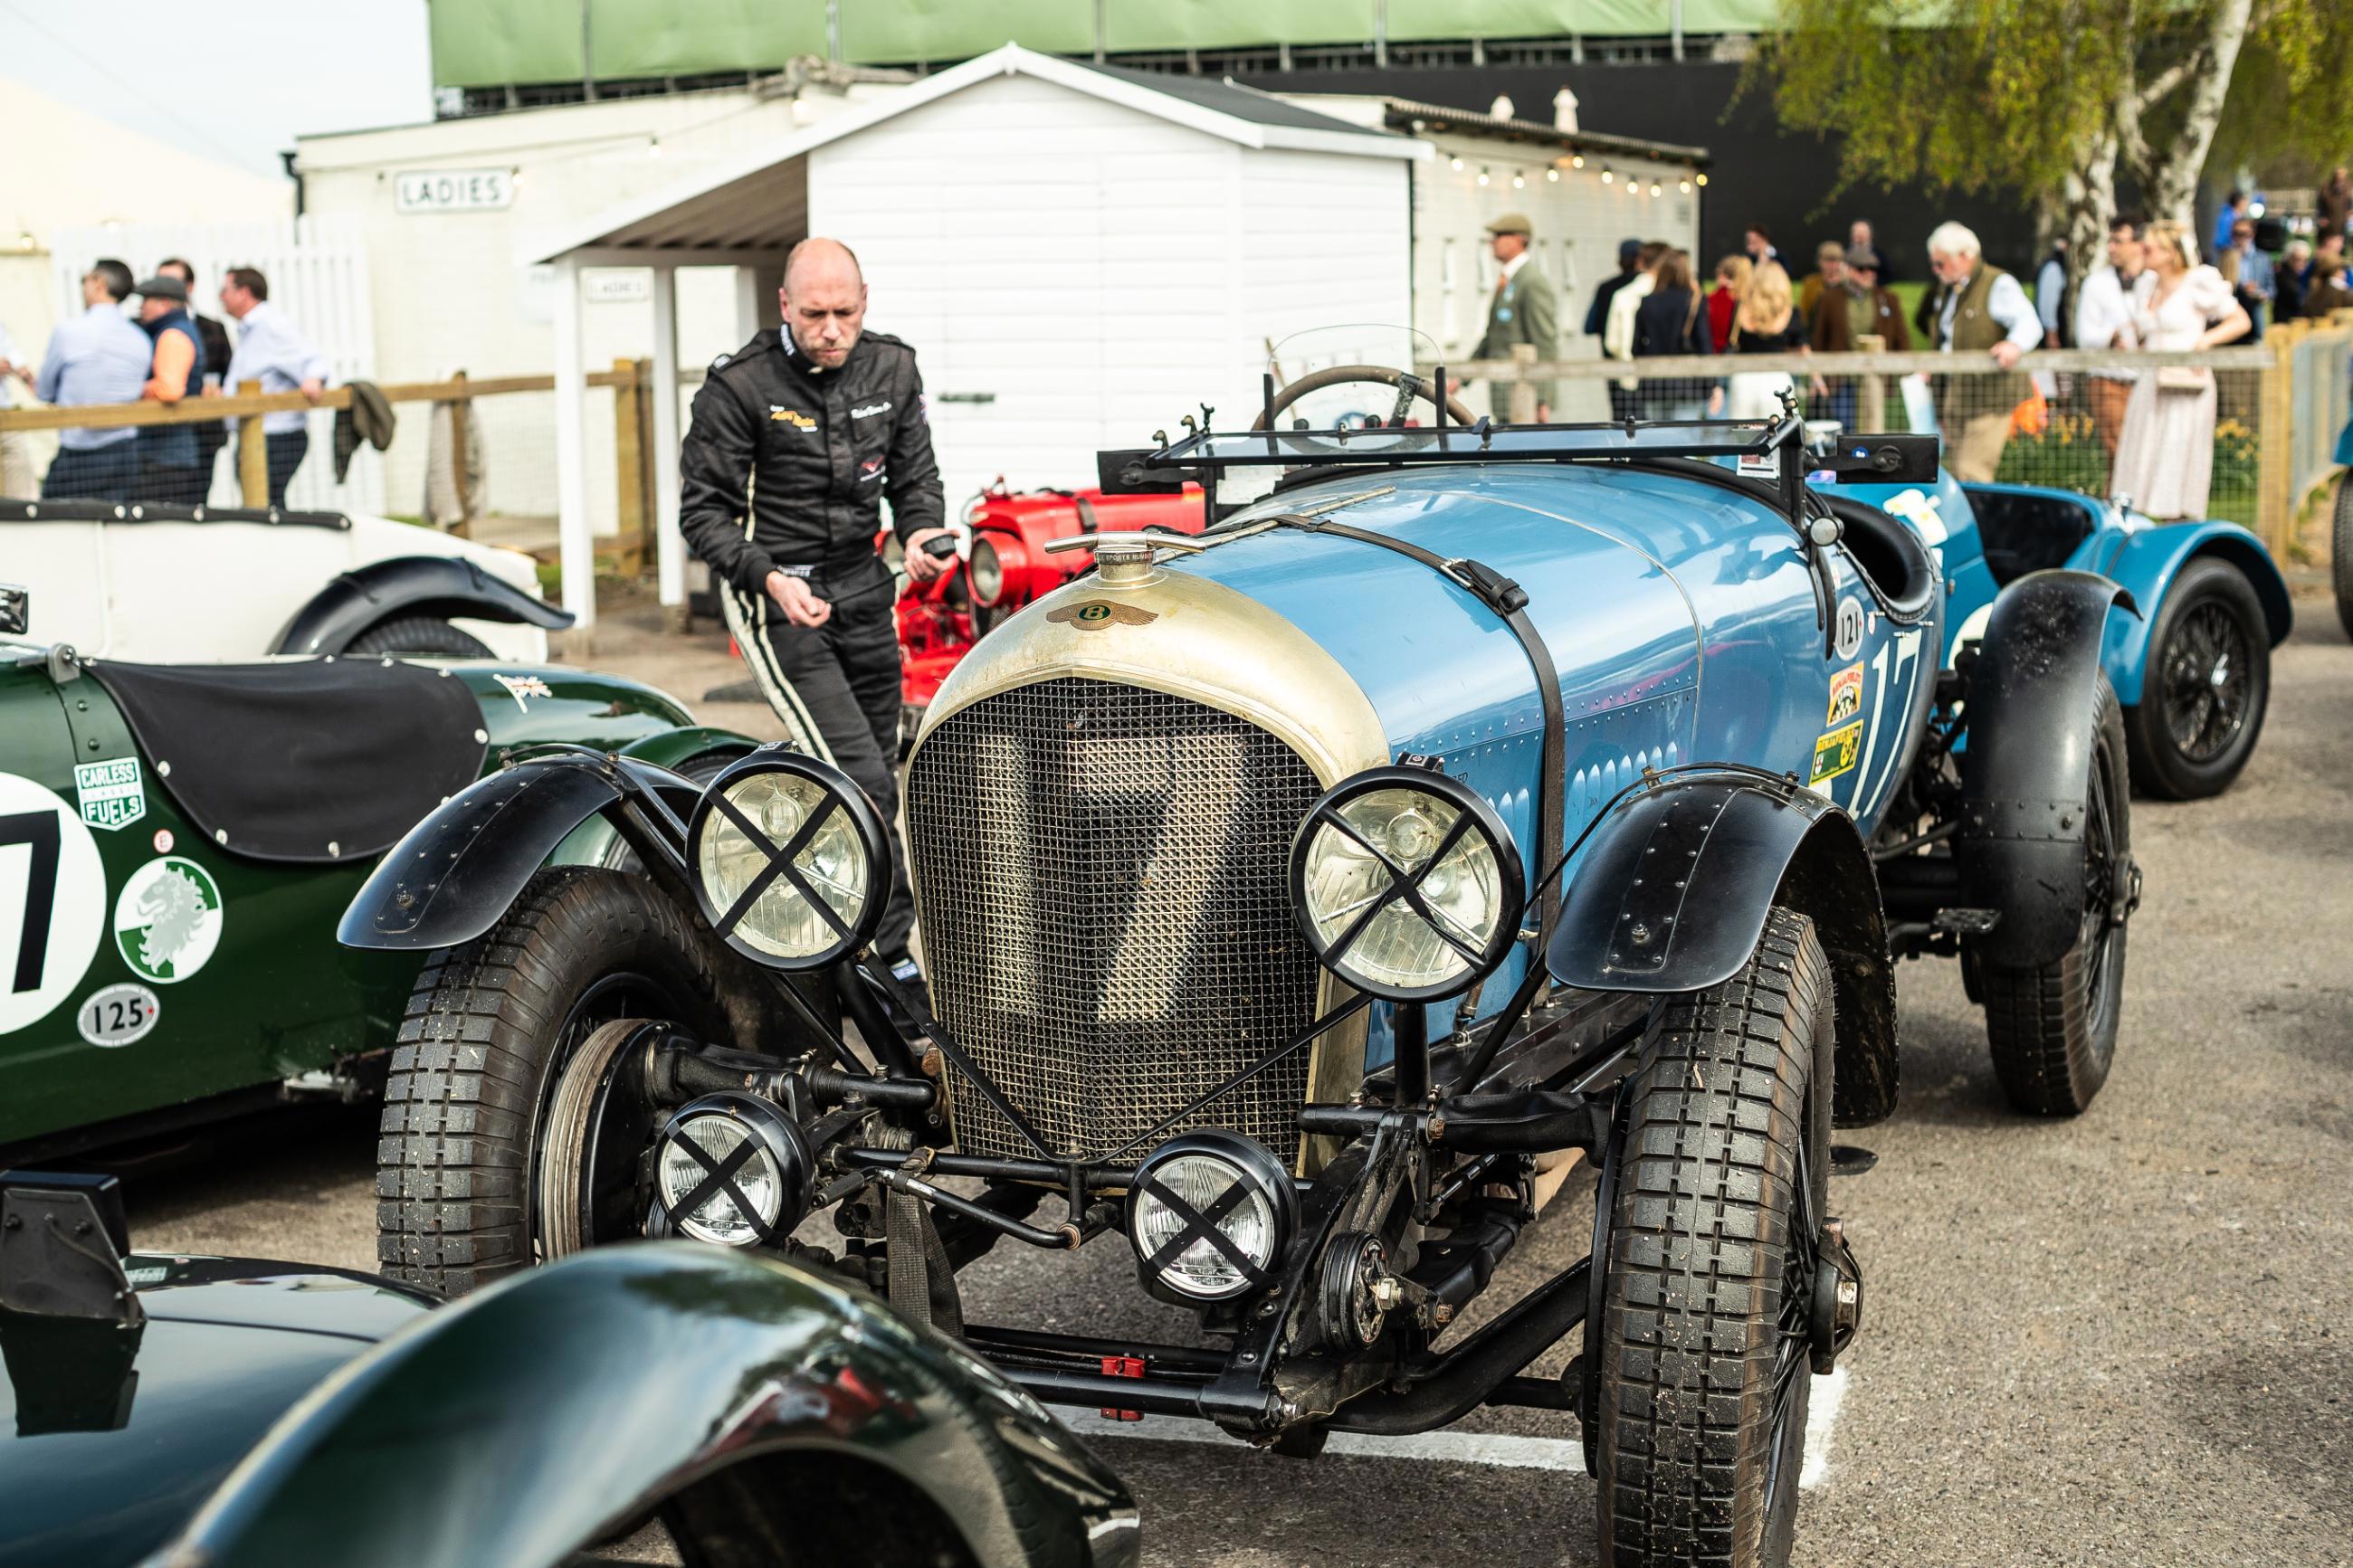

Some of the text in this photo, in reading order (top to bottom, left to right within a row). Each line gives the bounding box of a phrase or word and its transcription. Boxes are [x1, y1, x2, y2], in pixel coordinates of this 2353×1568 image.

[403, 176, 501, 205] LADIES
[1084, 605, 1105, 621] B
[1841, 611, 1860, 648] 121
[1847, 628, 1922, 821] 17
[80, 763, 137, 788] CARLESS
[85, 796, 141, 825] FUELS
[977, 732, 1246, 1022] 17
[94, 997, 144, 1034] 125
